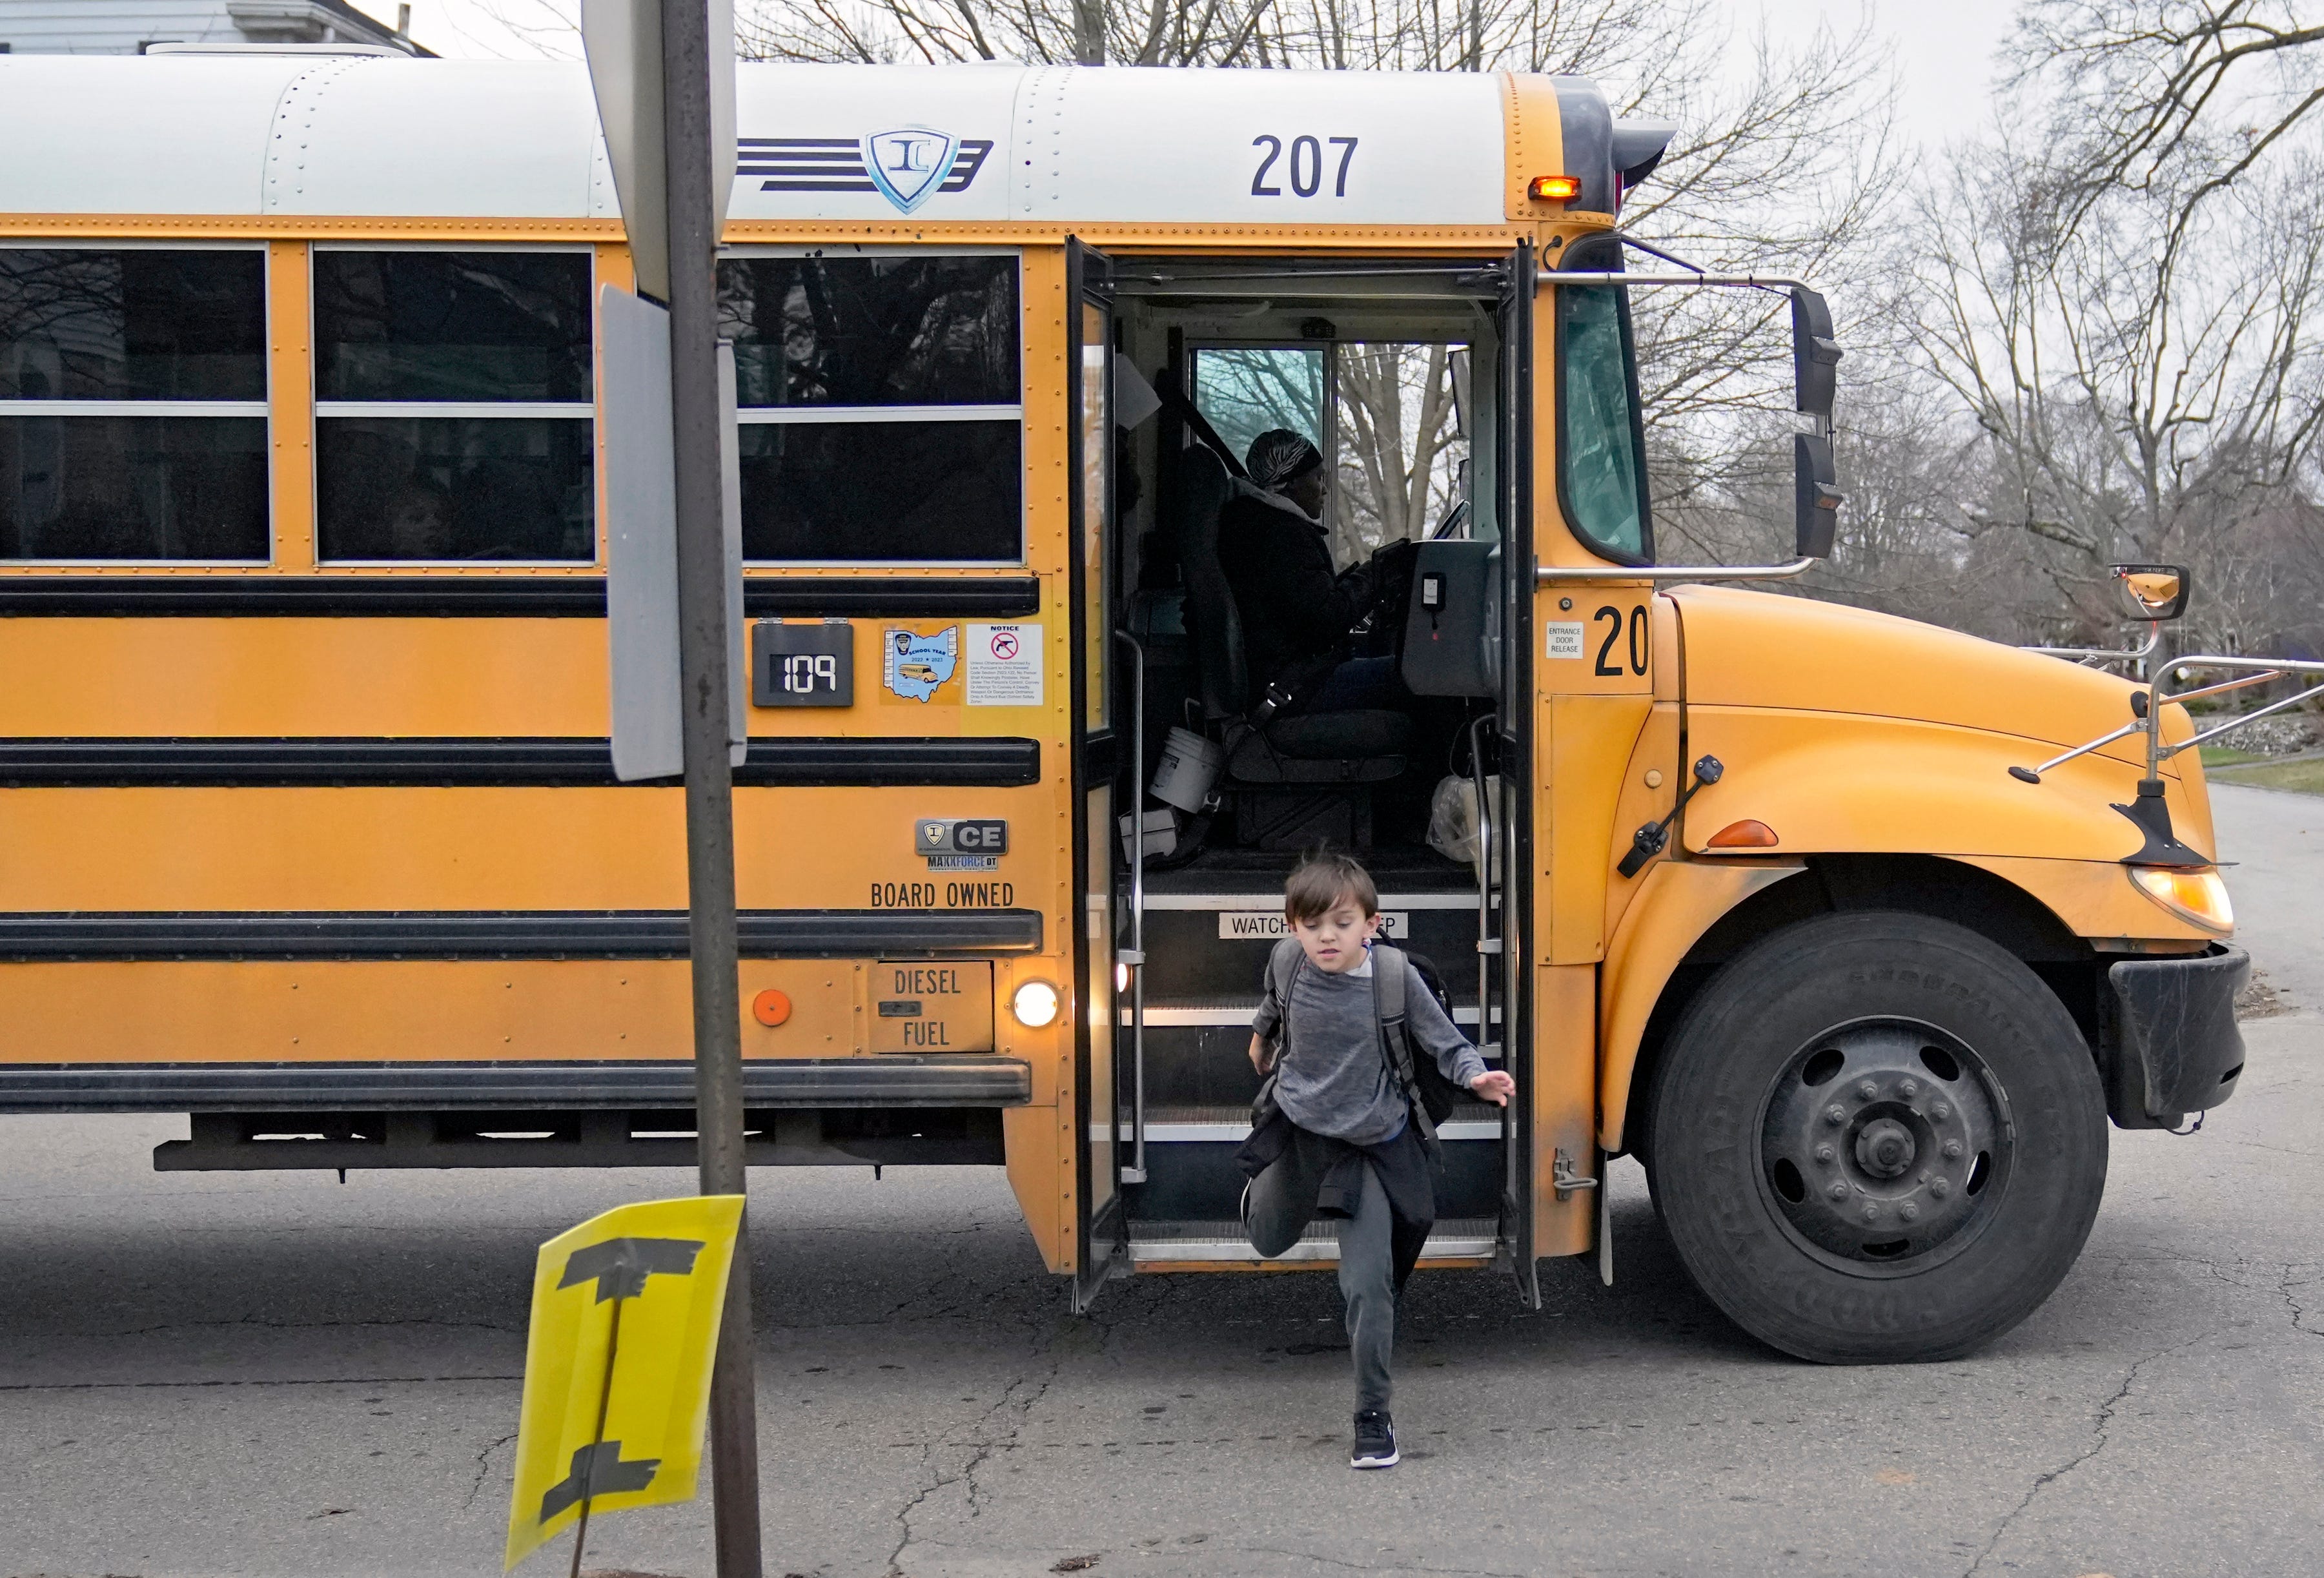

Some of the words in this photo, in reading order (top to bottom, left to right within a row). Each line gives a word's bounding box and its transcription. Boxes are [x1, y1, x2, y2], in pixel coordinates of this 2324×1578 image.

[1251, 134, 1358, 198] 207
[1594, 605, 1652, 676] 20
[784, 655, 837, 693] 109
[959, 826, 1001, 847] CE
[928, 856, 984, 867] MAXXFORCE
[986, 857, 996, 866] DT
[872, 882, 935, 907] BOARD
[947, 882, 1014, 907] OWNED
[1232, 917, 1290, 934] WATCH
[895, 970, 961, 994] DIESEL
[904, 1021, 950, 1046] FUEL
